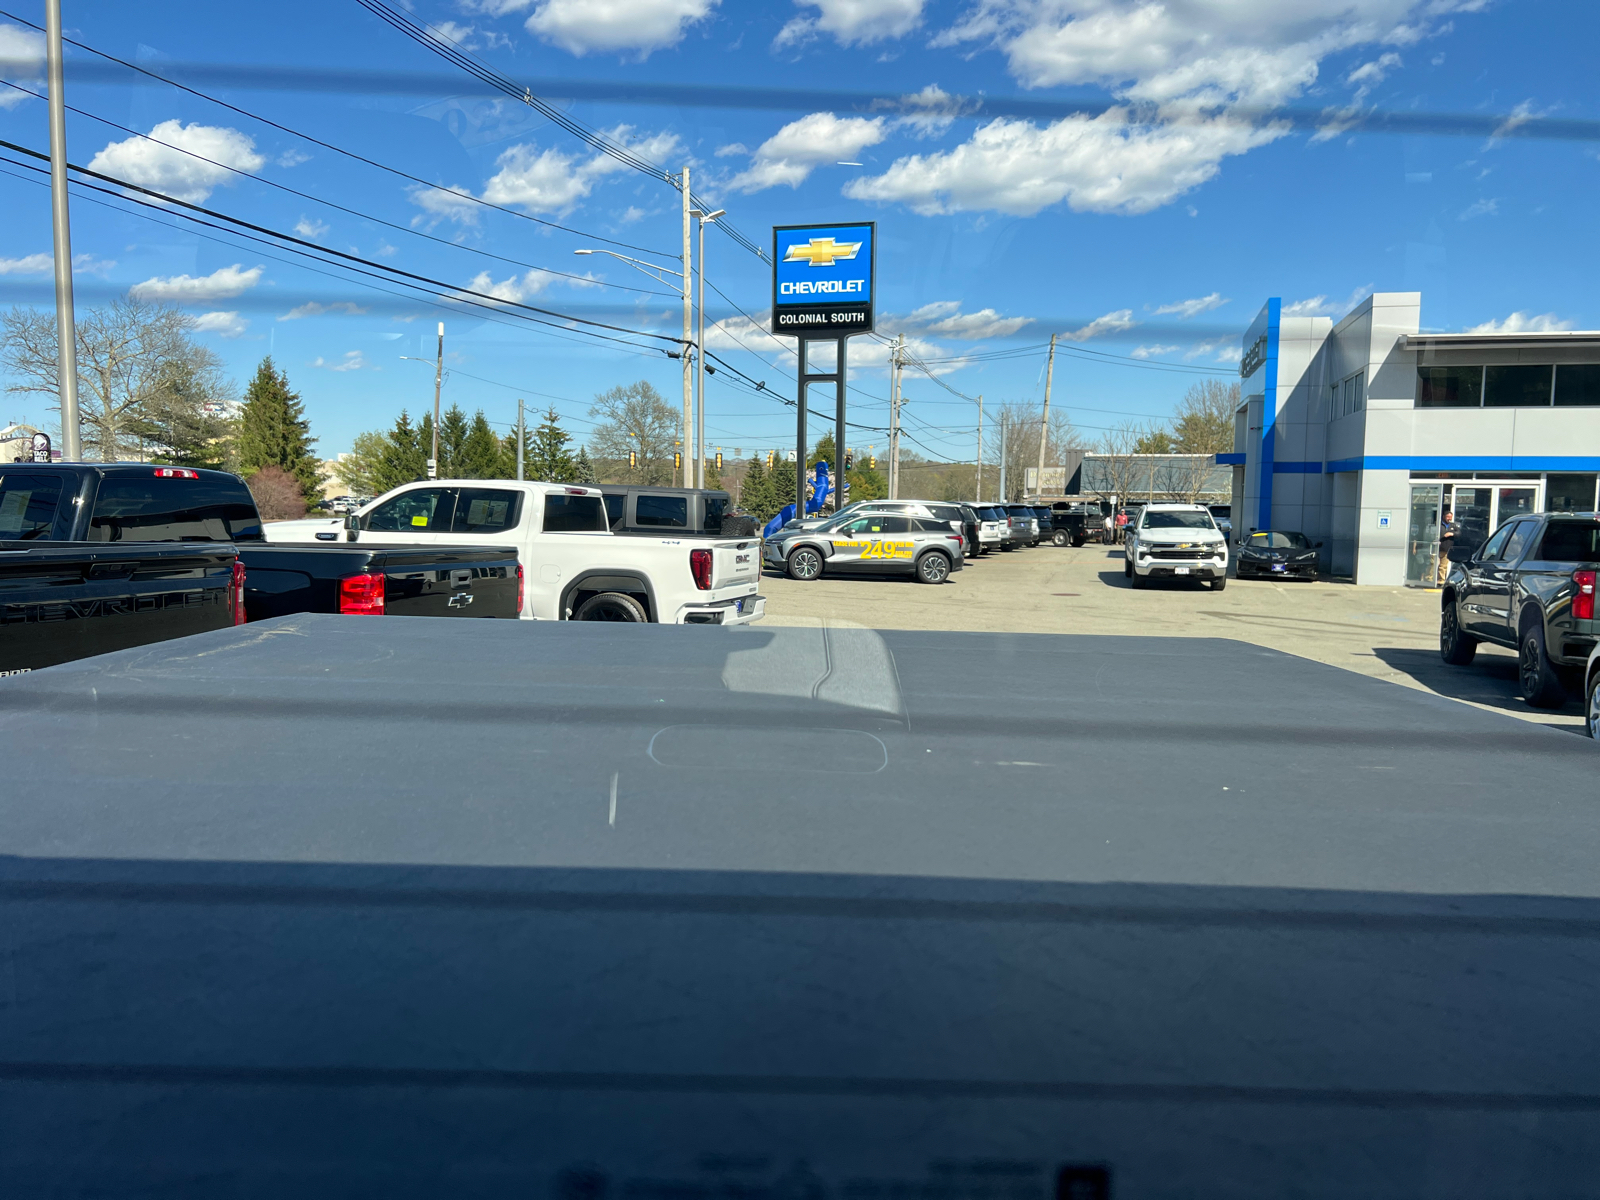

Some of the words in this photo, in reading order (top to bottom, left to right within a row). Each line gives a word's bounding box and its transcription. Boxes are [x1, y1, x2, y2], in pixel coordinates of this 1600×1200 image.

[780, 280, 865, 295] CHEVROLET
[779, 314, 828, 325] COLONIAL
[831, 312, 865, 323] SOUTH
